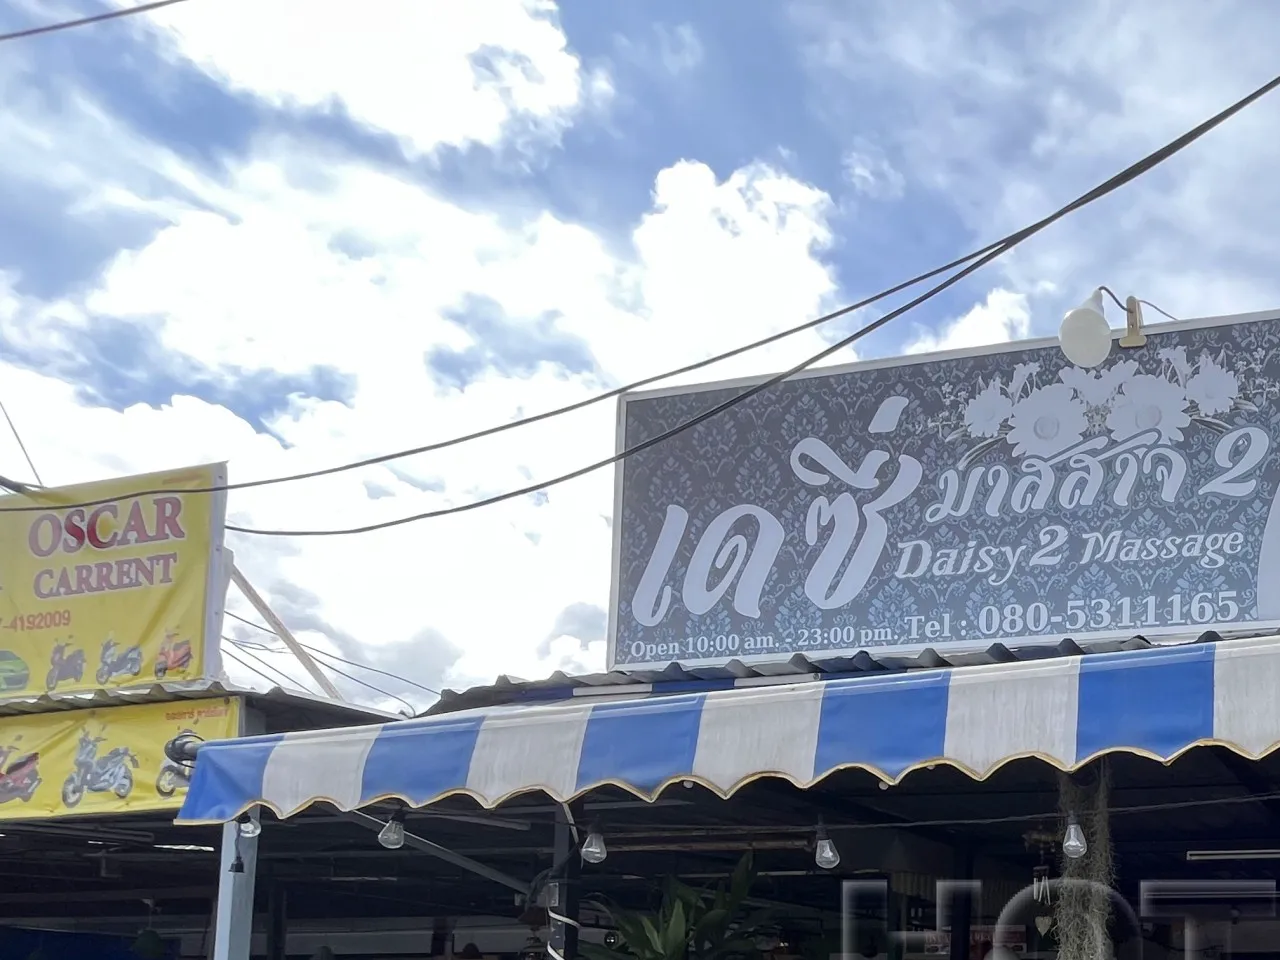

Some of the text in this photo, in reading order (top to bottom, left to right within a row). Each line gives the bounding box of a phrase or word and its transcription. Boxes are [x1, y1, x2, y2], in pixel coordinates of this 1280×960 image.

[1198, 425, 1271, 498] 2
[28, 497, 186, 558] OSCAR
[631, 395, 924, 627] เดซี่
[33, 552, 178, 600] CARRENT
[895, 525, 1245, 586] Daisy 2 Massage
[631, 637, 680, 660] Open
[685, 633, 740, 654] 10:00
[744, 634, 780, 650] am.
[797, 625, 855, 647] 23:00
[977, 590, 1239, 635] 080-5311165
